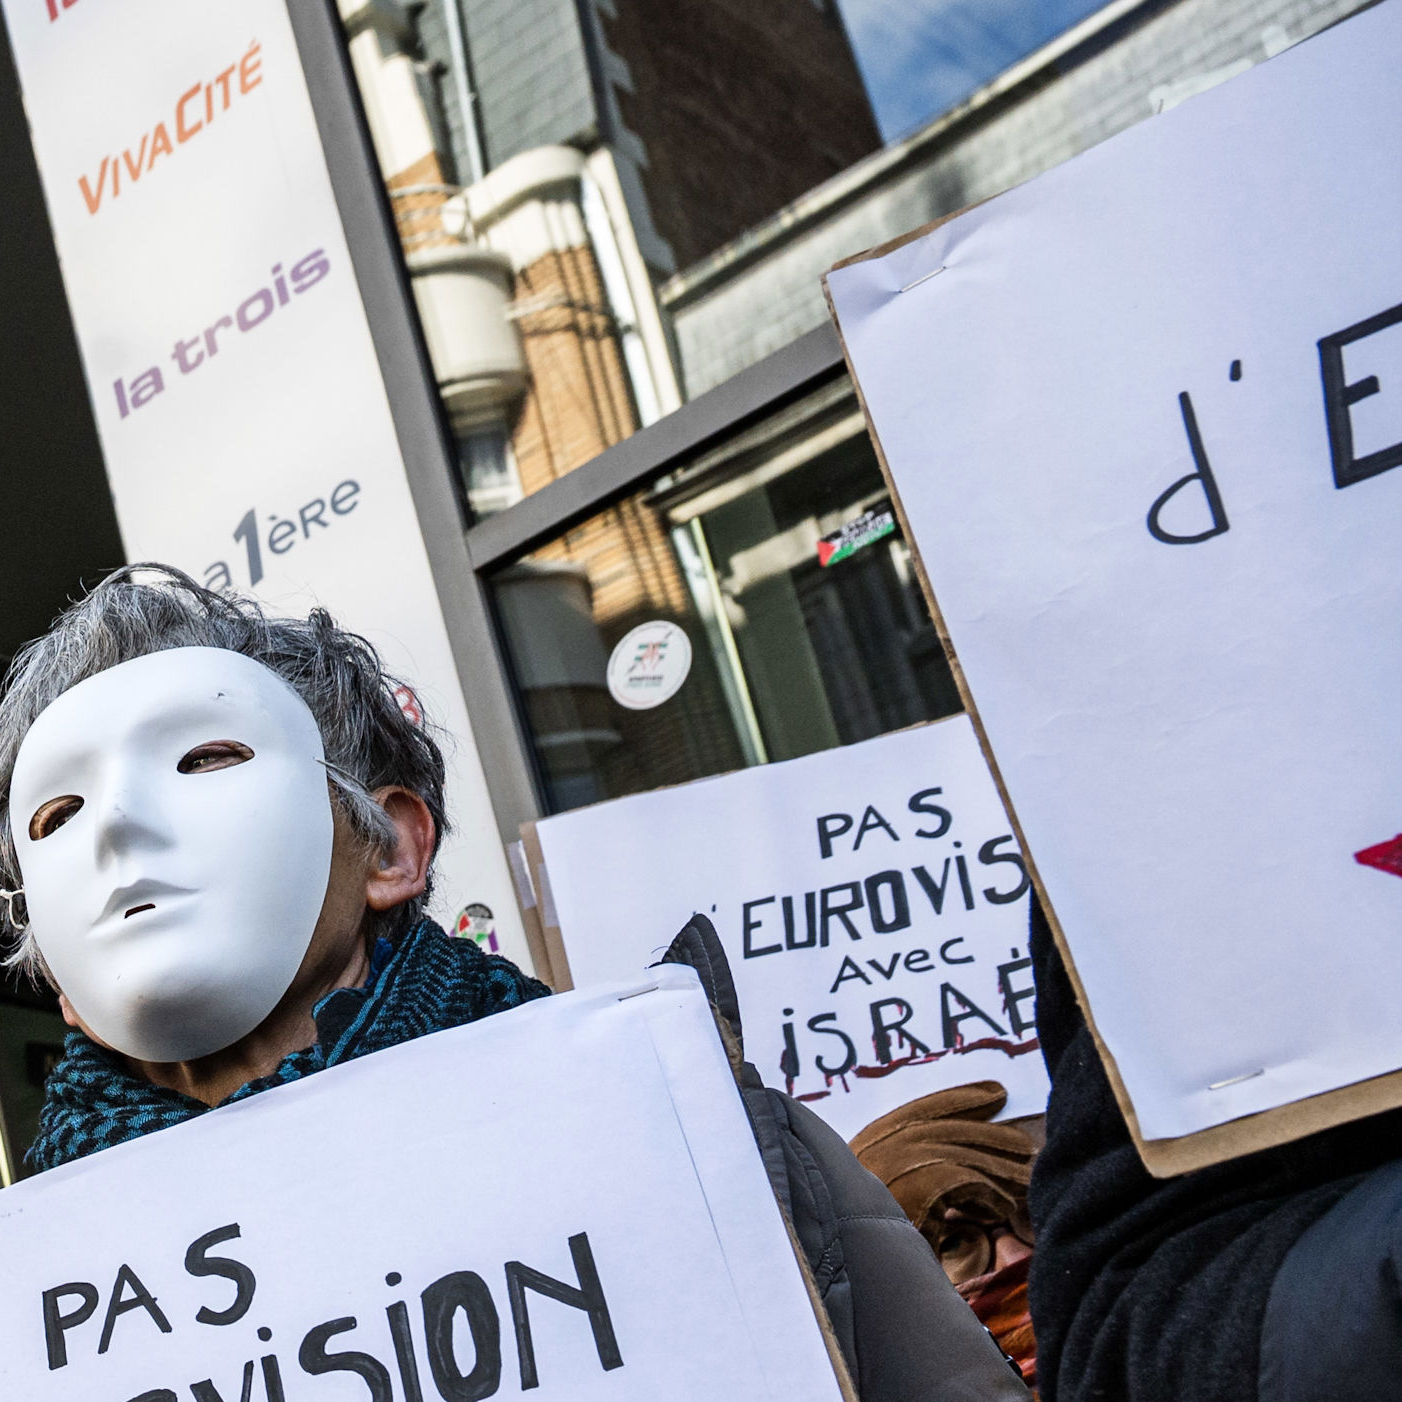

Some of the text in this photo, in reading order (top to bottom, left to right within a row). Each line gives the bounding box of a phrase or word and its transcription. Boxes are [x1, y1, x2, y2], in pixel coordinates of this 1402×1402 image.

[112, 247, 331, 421] la trois
[816, 786, 953, 860] PAS
[829, 936, 975, 994] Avec
[42, 1223, 256, 1371] PAS
